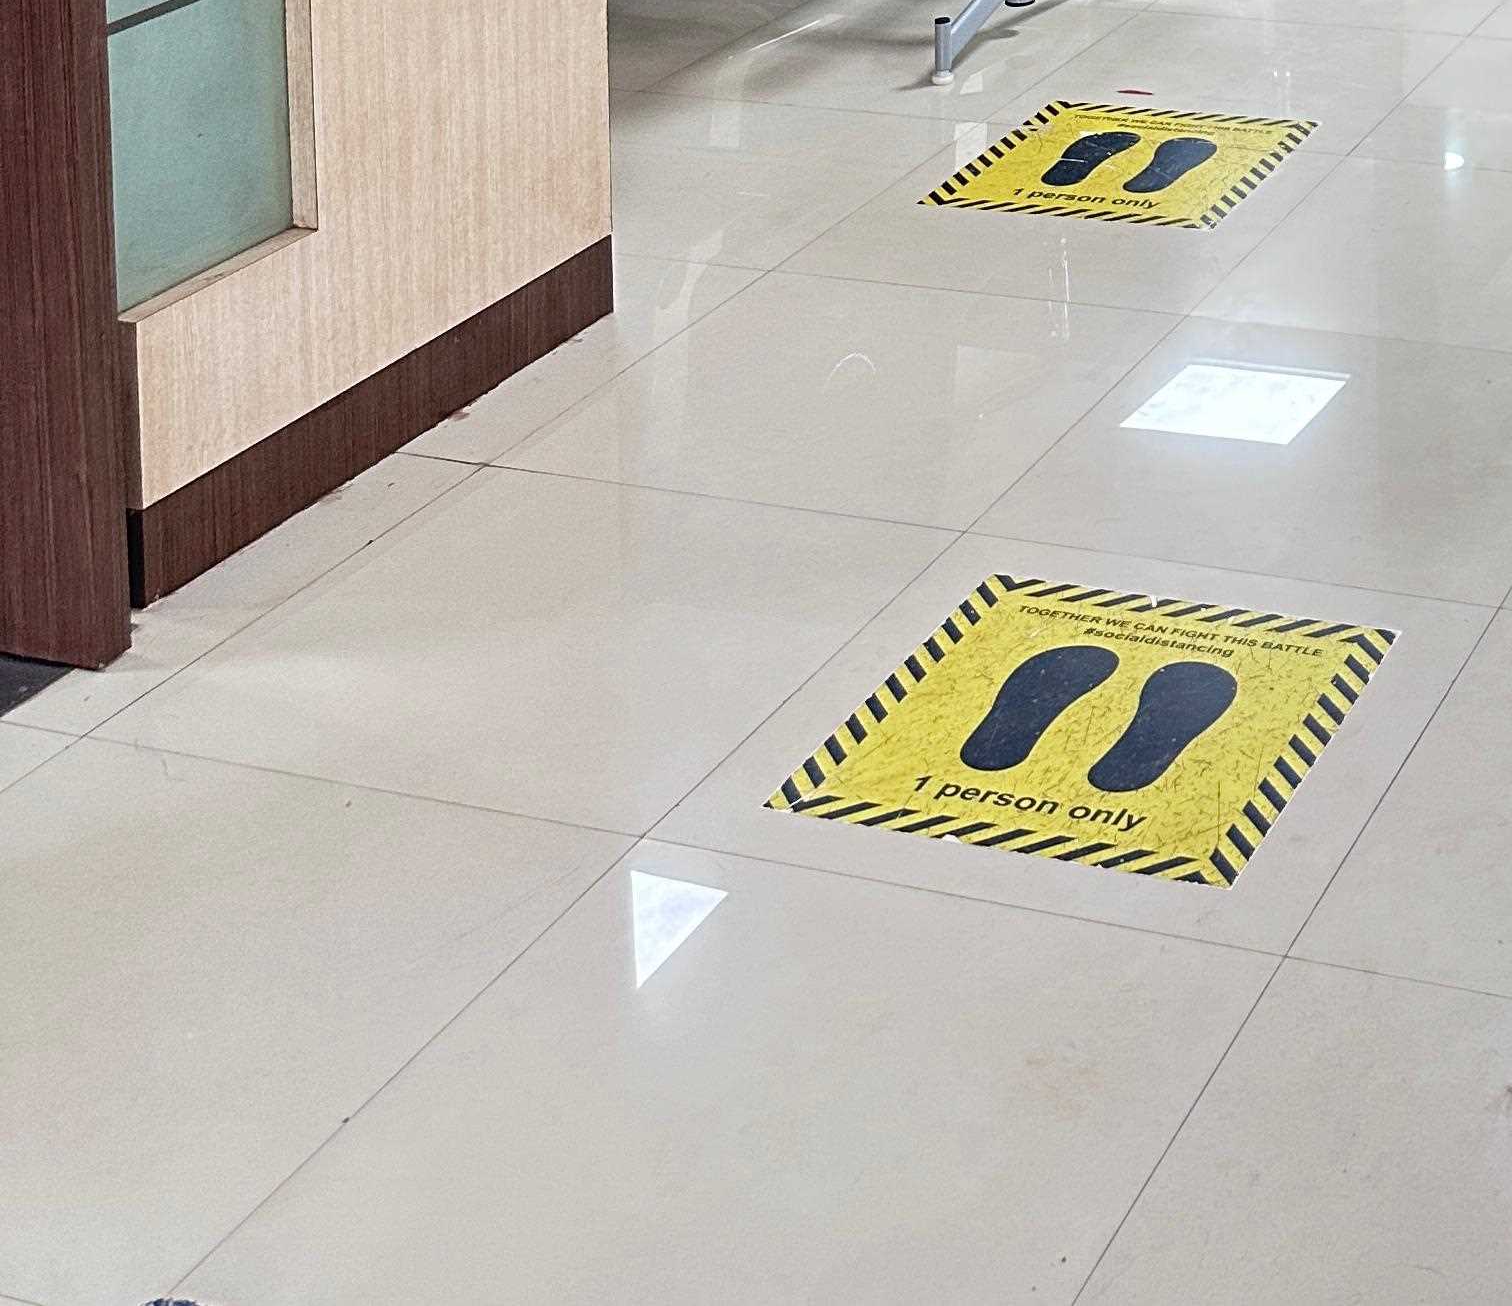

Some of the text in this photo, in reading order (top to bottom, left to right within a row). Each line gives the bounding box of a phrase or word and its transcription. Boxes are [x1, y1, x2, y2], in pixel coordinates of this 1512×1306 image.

[1012, 188, 1161, 209] 1 person only
[1018, 604, 1324, 657] TOGETHER WE CAN FIGHT THIS BATTLE
[1082, 627, 1235, 659] #socialdistancing
[913, 775, 1148, 832] 1 person only
